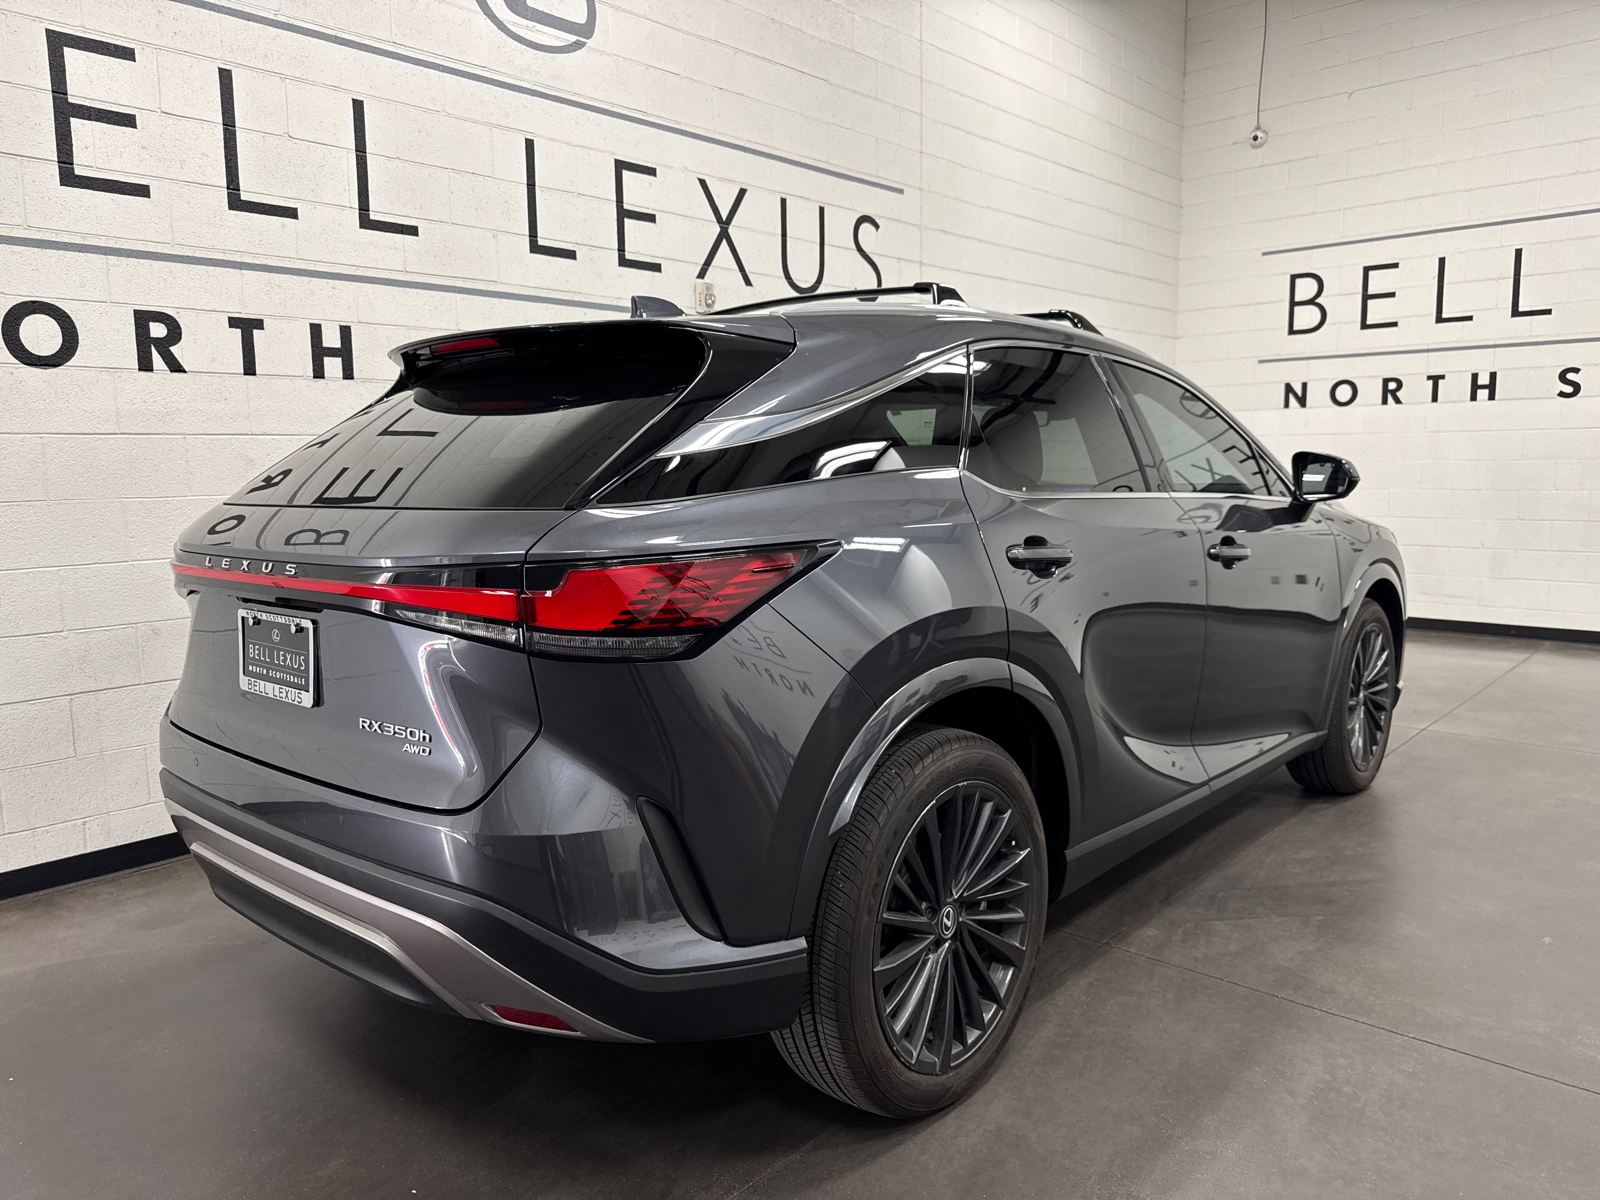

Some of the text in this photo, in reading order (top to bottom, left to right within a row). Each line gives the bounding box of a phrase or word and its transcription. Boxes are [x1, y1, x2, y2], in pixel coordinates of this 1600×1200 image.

[524, 137, 882, 302] LEXUS
[1287, 247, 1553, 336] BELL
[1, 300, 354, 381] ORTH
[1283, 366, 1582, 409] NORTH S
[205, 556, 298, 575] LEXUS
[249, 644, 305, 670] BELL LEXUS
[249, 664, 305, 685] NORTH SCOTTSDALE
[247, 678, 303, 704] BELL LEXUS
[359, 717, 432, 743] RX350h
[402, 743, 431, 756] AWD
